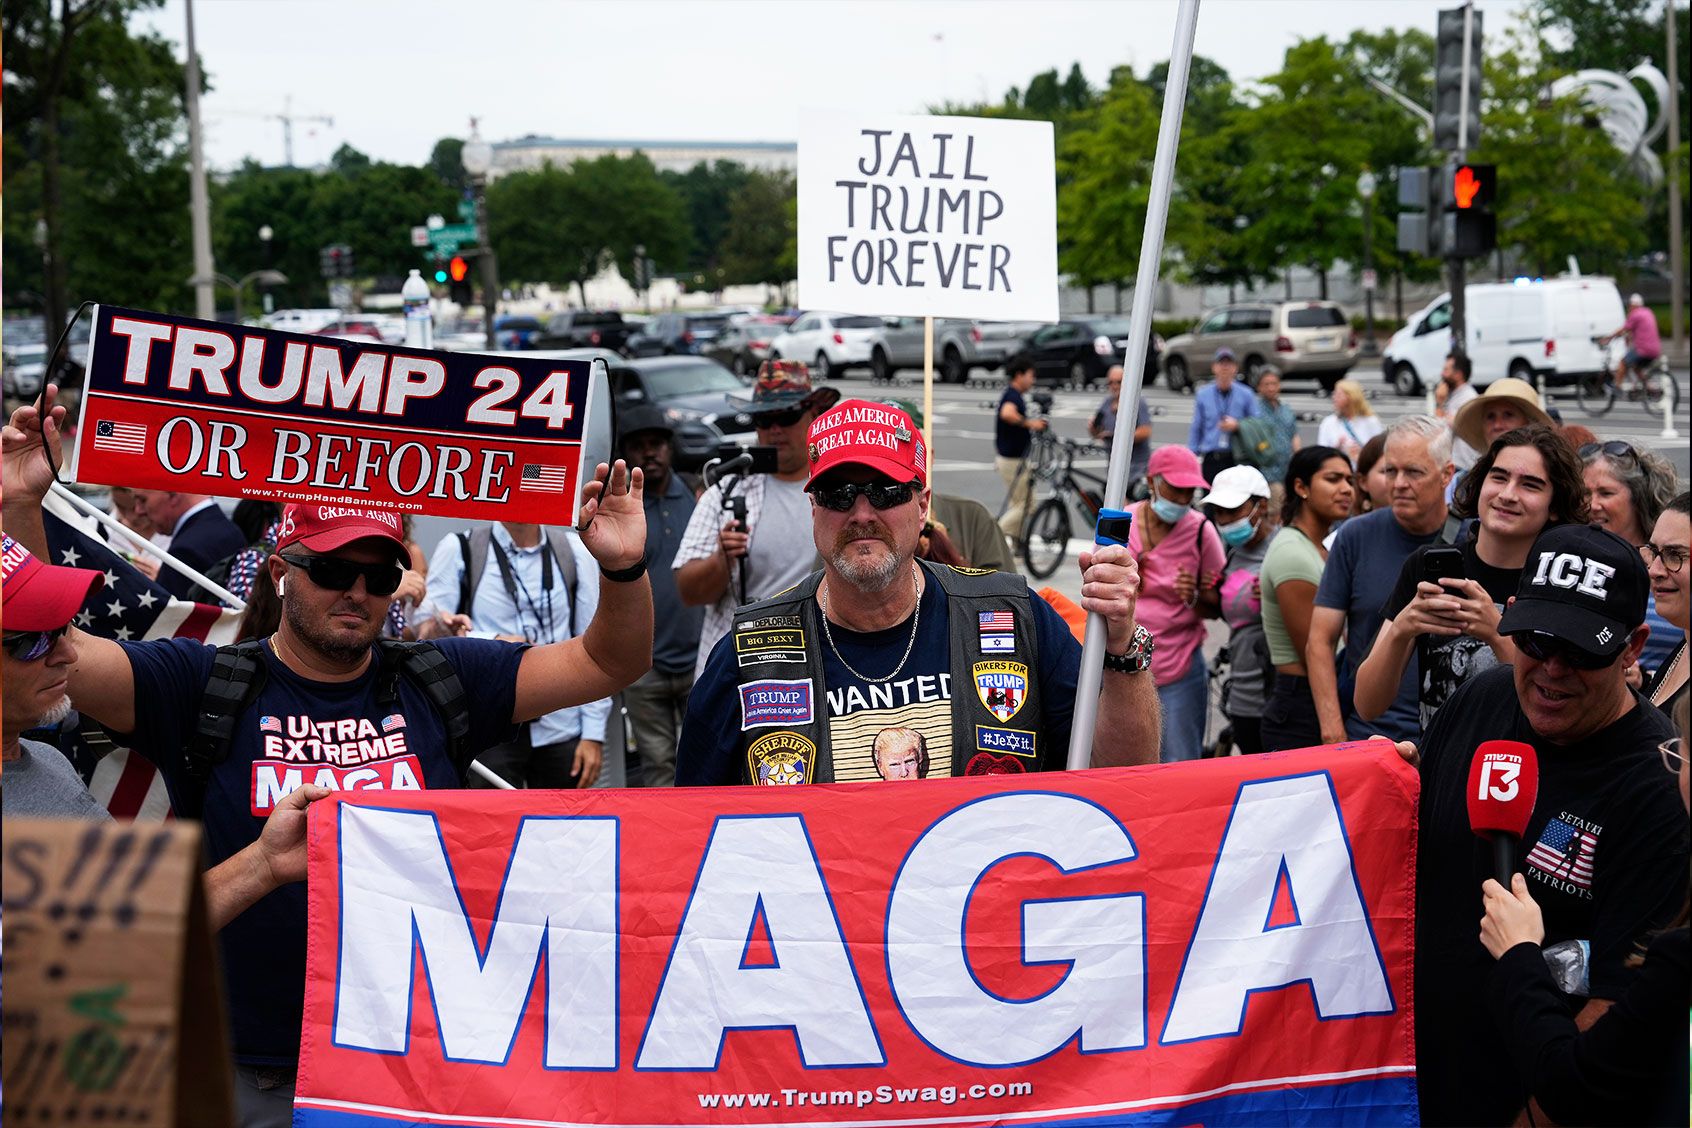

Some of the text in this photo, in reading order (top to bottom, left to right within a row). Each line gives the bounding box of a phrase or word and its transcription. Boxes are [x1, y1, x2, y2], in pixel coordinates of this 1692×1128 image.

[858, 129, 988, 181] JAIL
[835, 180, 1004, 236] TRUMP
[827, 235, 1012, 292] FOREVER
[111, 316, 575, 430] TRUMP 24
[811, 407, 906, 438] MAKE AMERICA
[816, 429, 899, 457] GREAT AGAIN
[156, 415, 514, 504] OR BEFORE
[242, 487, 423, 510] www.TrumpHandBanners.com
[318, 505, 398, 530] GREAT AGAIN
[1531, 551, 1617, 602] ICE
[754, 616, 801, 628] DEPLORABLE
[747, 635, 794, 646] BIG SEXY
[1595, 626, 1614, 646] ICE
[757, 653, 787, 661] VIRGINIA
[974, 662, 1026, 674] BIKERS FOR
[977, 674, 1024, 688] TRUMP
[749, 691, 801, 706] TRUMP
[265, 732, 408, 766] EXTREME
[754, 737, 810, 759] SHERIFF
[1483, 752, 1522, 764] חדשות
[1478, 761, 1520, 801] 13
[1527, 865, 1594, 901] PATRIOTS
[332, 770, 1395, 1069] MAGA
[698, 1081, 1033, 1108] www.TrumpSwag.com
